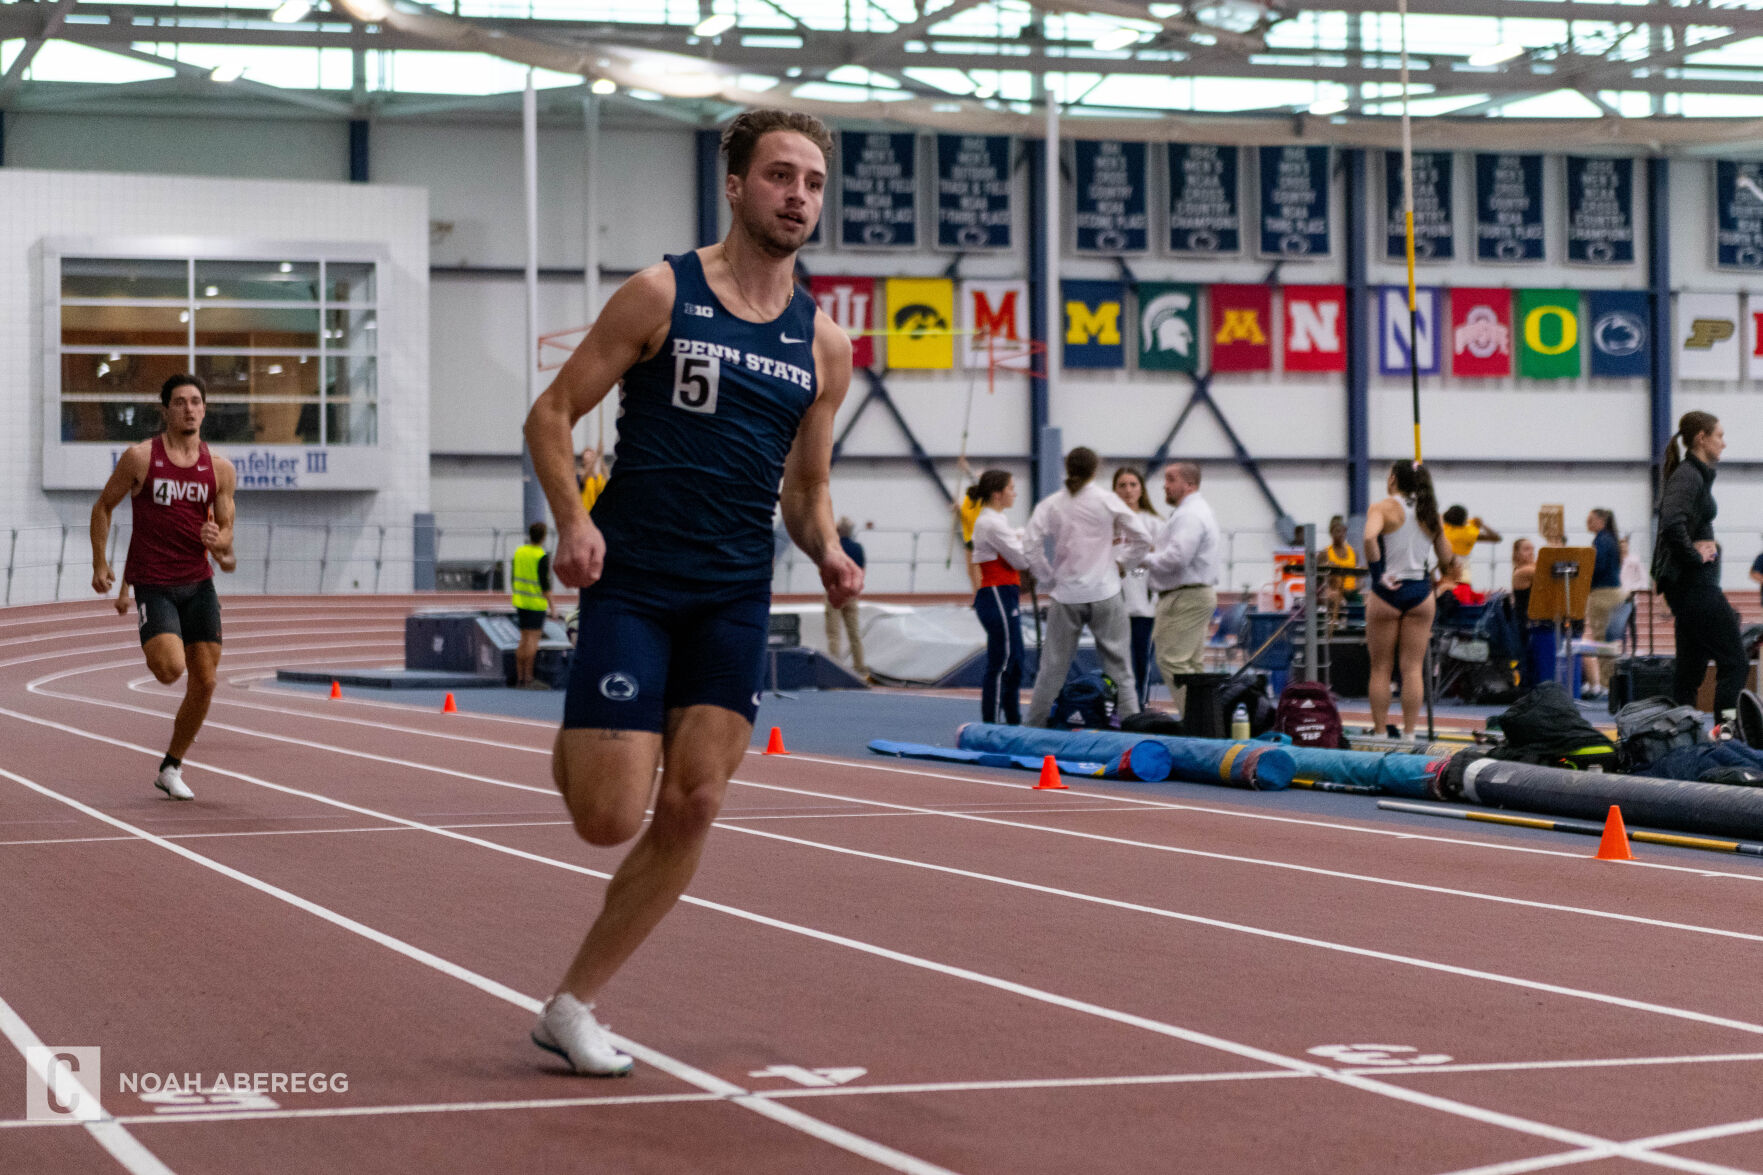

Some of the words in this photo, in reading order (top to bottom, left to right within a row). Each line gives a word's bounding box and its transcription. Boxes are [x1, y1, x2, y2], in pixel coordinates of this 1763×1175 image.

[684, 302, 714, 318] B1G
[973, 290, 1018, 341] M
[1066, 301, 1120, 345] M
[1215, 309, 1265, 344] M
[1290, 300, 1339, 352] N
[1386, 290, 1433, 368] N
[1524, 305, 1577, 355] O
[1684, 318, 1735, 349] P
[671, 338, 741, 364] PENN
[745, 353, 812, 391] STATE
[679, 358, 710, 408] 5
[306, 452, 328, 473] III
[156, 482, 169, 503] 4
[169, 481, 208, 502] AVEN
[1305, 1043, 1454, 1065] 3
[747, 1065, 868, 1086] 4
